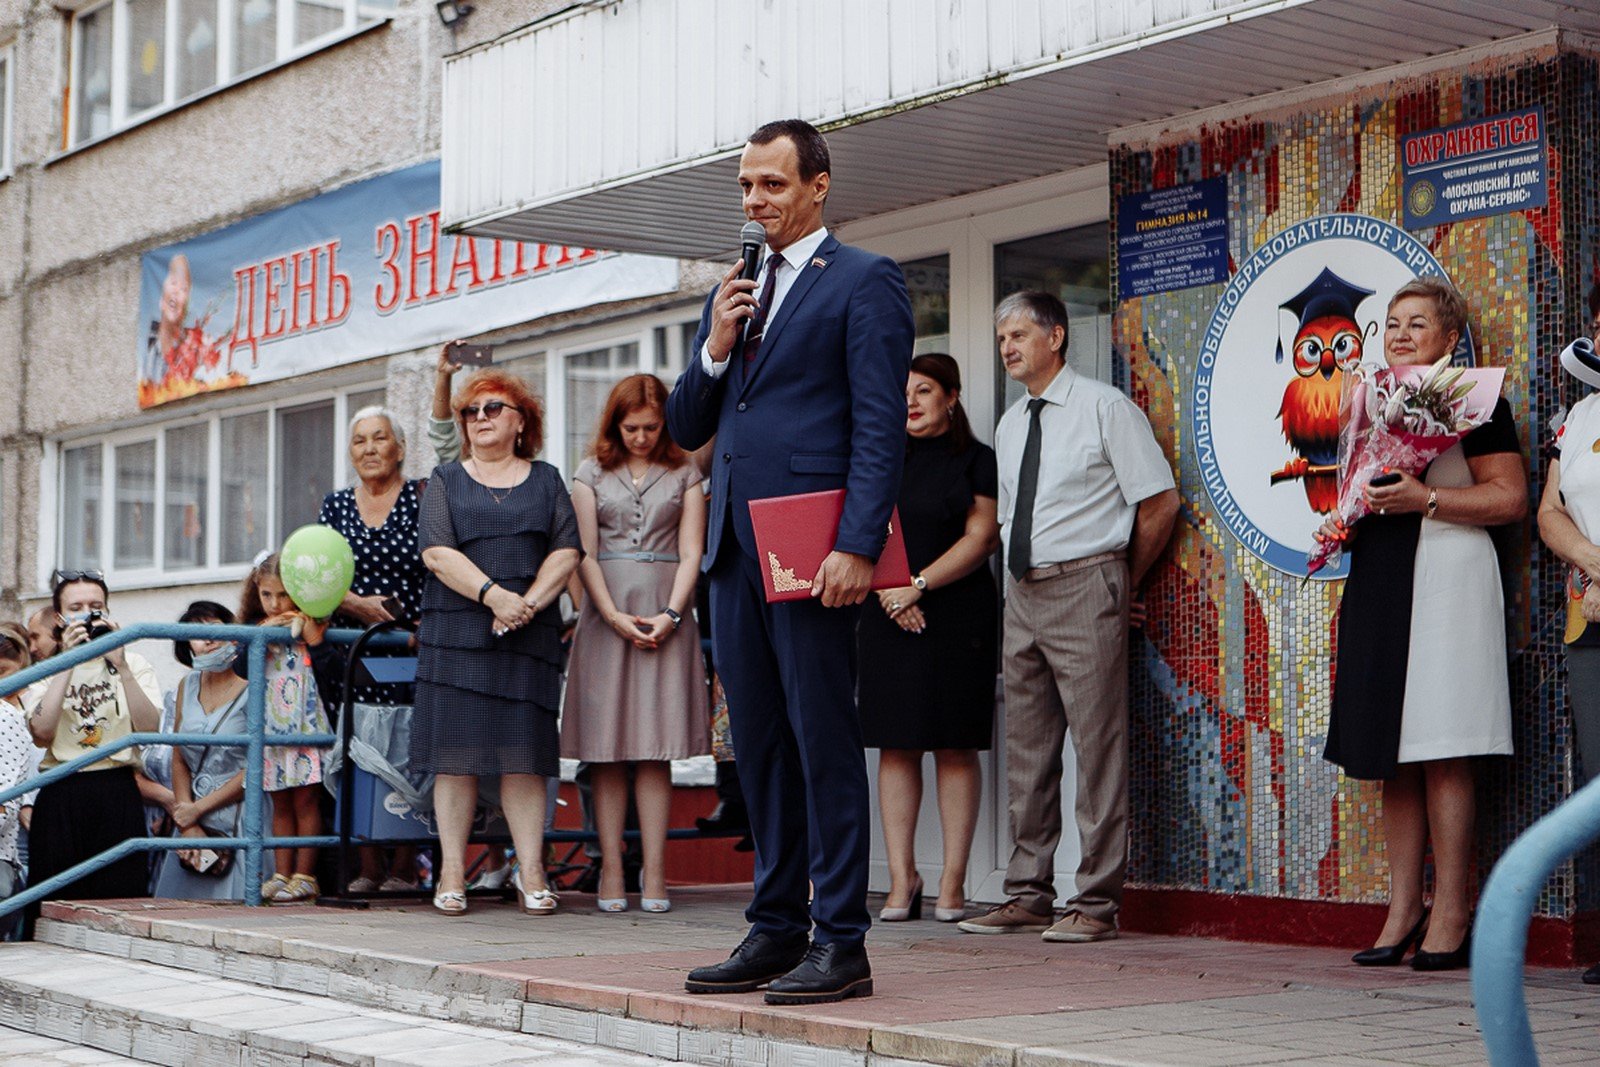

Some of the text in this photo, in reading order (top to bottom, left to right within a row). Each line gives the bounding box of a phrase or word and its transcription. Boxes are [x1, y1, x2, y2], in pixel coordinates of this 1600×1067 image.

[1405, 112, 1539, 166] ОХРАНЯЕТСЯ
[1497, 154, 1539, 171] ОРГАНИЗАЦИЯ
[1442, 170, 1540, 199] «МОСКОВСКИЙ ДОМ:
[1450, 188, 1531, 215] ОХРАНА-СЕРВИС»
[1136, 211, 1186, 232] ГИМНАЗИЯ
[227, 211, 621, 370] ДЕНЬ ЗНА
[1201, 217, 1393, 369] ОБЩЕОБРАЗОВАТЕЛЬНОЕ
[1195, 374, 1270, 556] МУНИЦИПАЛЬНОЕ
